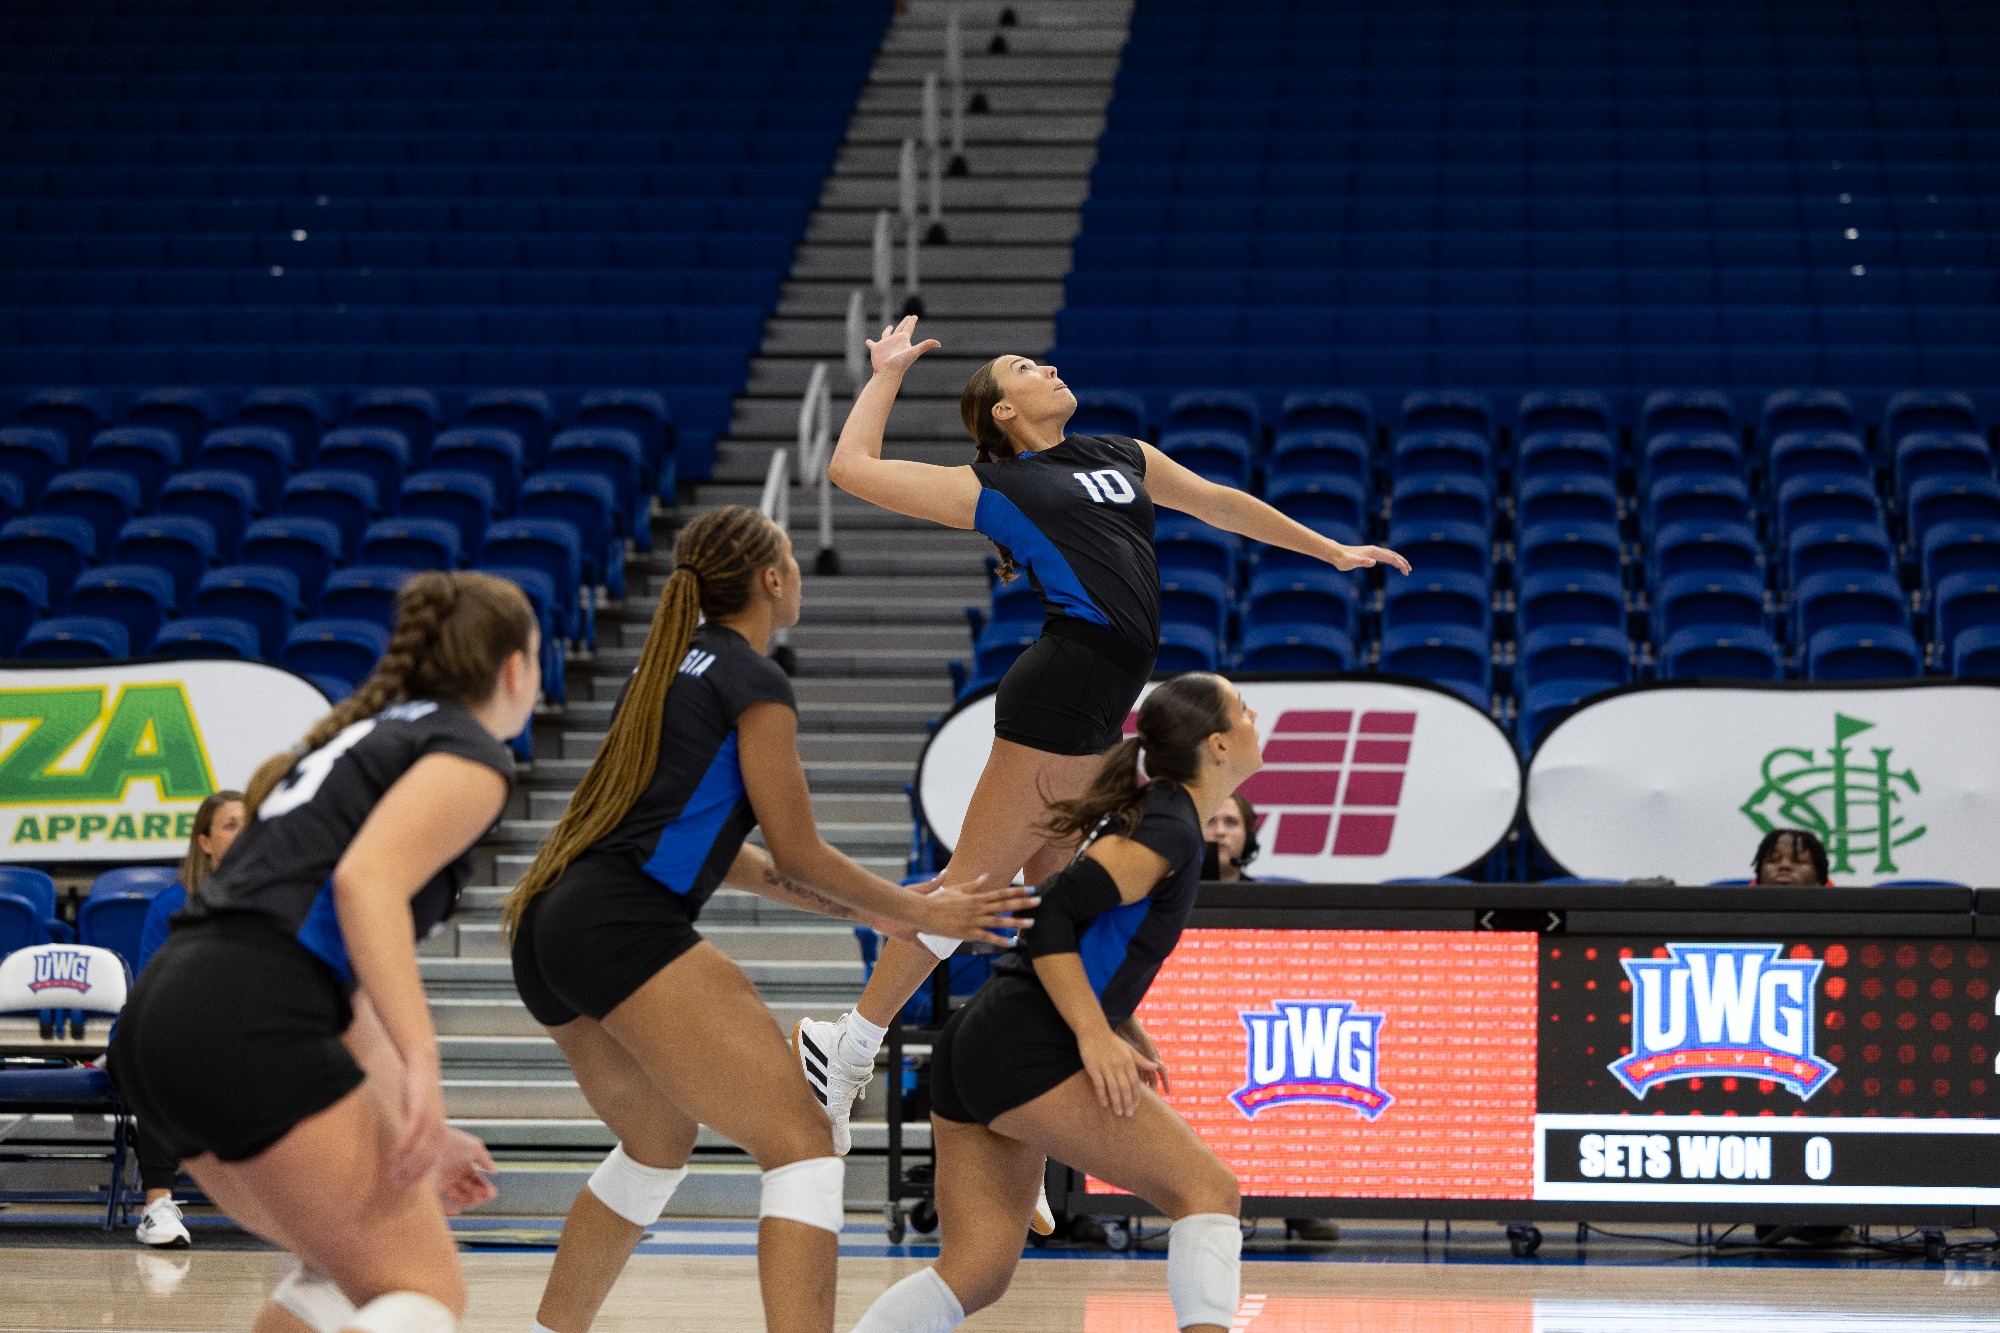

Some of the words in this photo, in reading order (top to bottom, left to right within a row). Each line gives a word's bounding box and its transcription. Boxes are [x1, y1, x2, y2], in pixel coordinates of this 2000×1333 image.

[1072, 469, 1136, 504] 10
[9, 813, 196, 845] APPARE
[34, 951, 90, 983] UWG
[1638, 952, 1803, 1056] UWG
[1251, 1006, 1373, 1089] UWG
[1579, 1133, 1672, 1178] SETS
[1677, 1135, 1772, 1179] WON
[1804, 1136, 1832, 1180] 0
